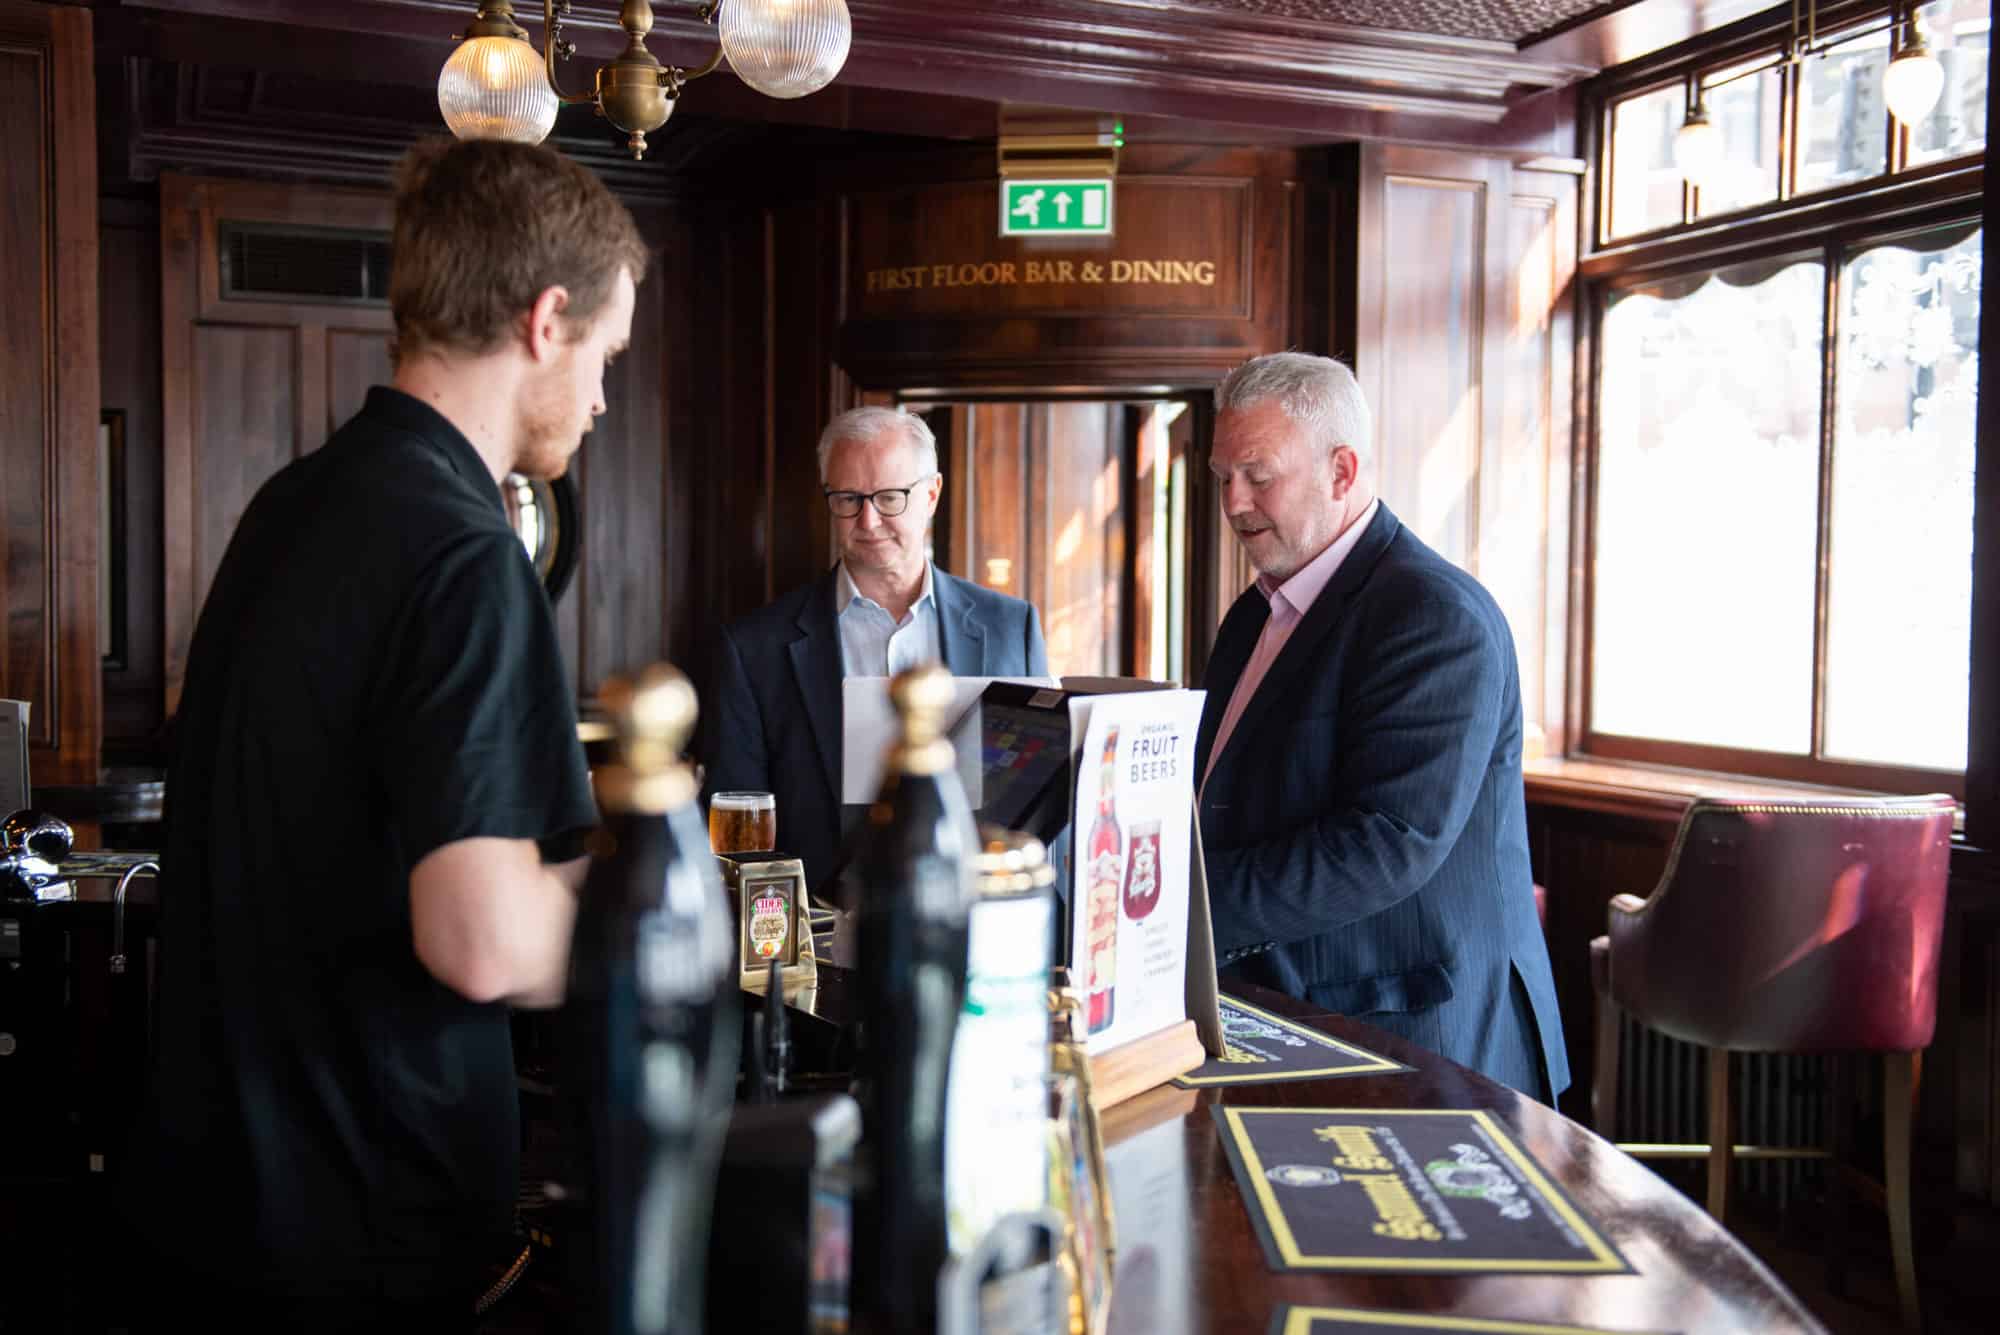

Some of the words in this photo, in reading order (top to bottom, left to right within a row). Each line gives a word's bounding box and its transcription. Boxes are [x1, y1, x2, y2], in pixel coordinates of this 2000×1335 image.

[866, 266, 928, 291] FIRST
[931, 262, 1017, 287] FLOOR
[1025, 260, 1077, 284] BAR
[1080, 261, 1104, 283] &
[1111, 260, 1216, 286] DINING
[1132, 735, 1180, 758] FRUIT
[1130, 758, 1177, 783] BEERS
